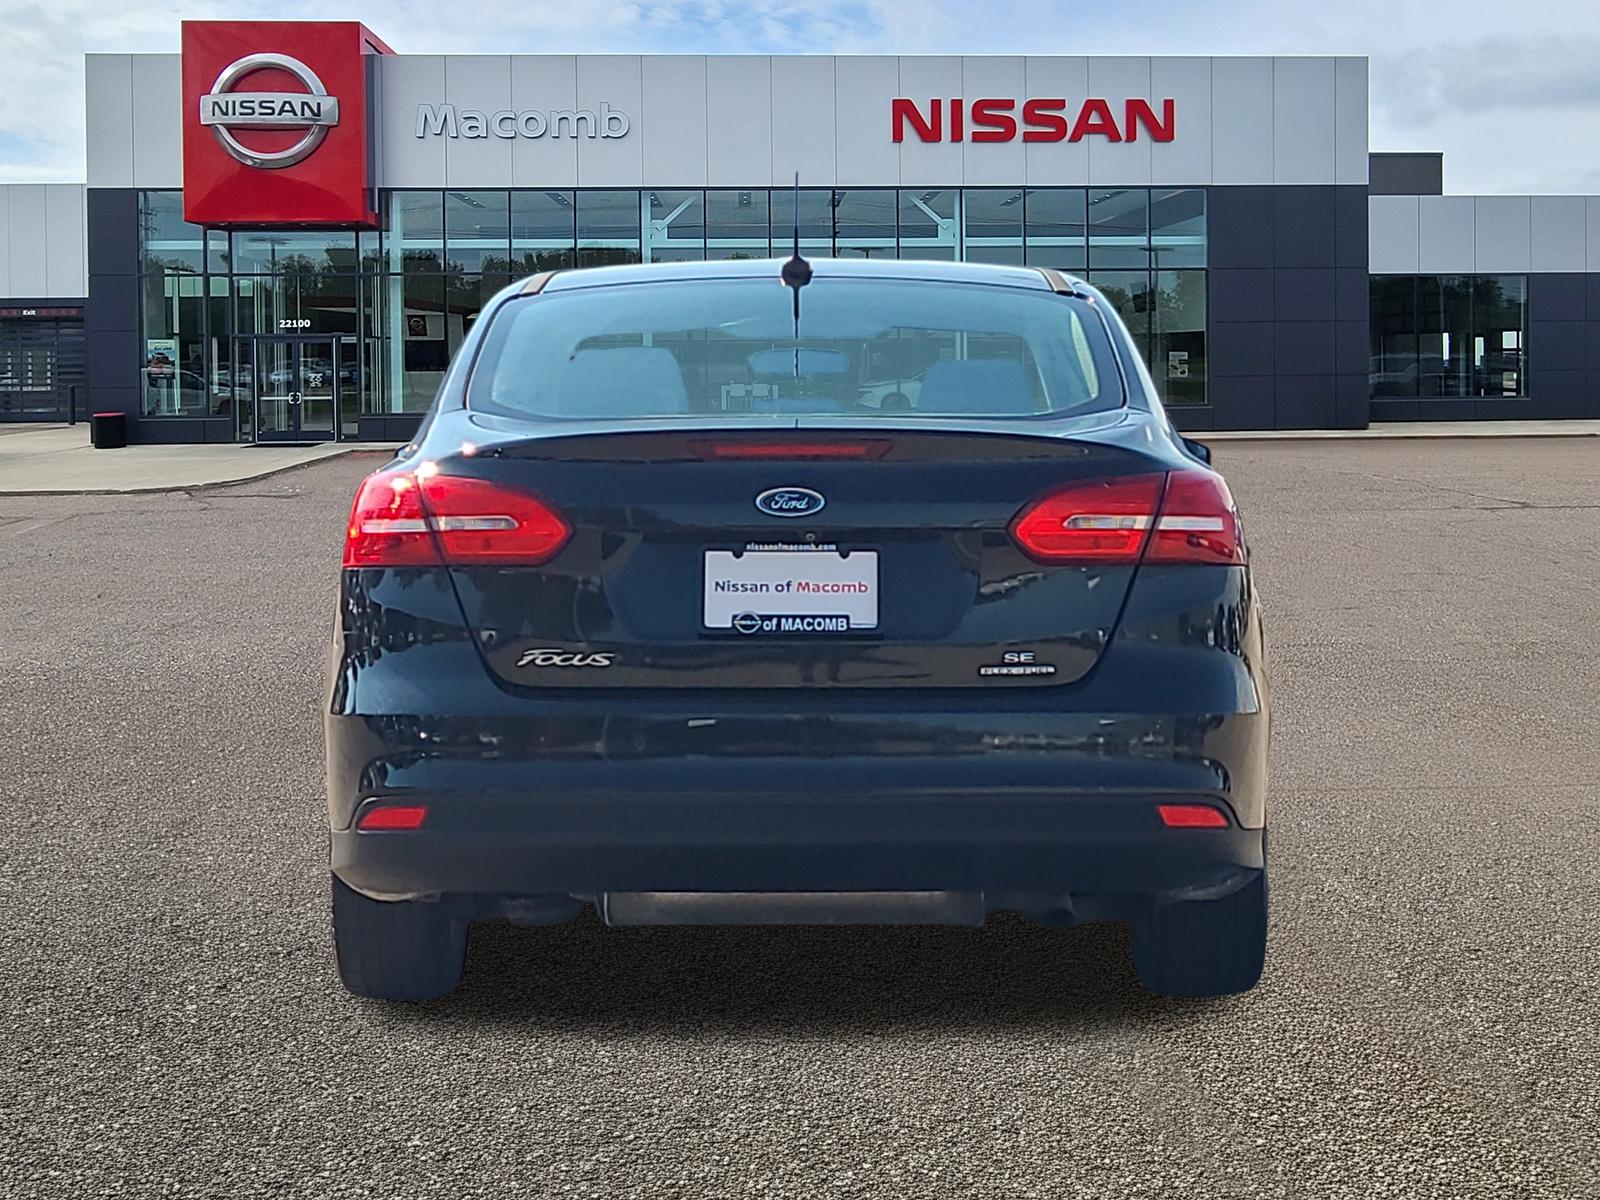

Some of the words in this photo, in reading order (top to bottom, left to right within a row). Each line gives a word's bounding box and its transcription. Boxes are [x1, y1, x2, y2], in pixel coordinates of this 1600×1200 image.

[211, 99, 322, 119] NISSAN
[415, 102, 631, 139] Macomb
[892, 98, 1176, 143] NISSAN
[279, 319, 311, 328] 22100
[770, 493, 809, 510] Ford
[714, 580, 770, 593] Nissan
[774, 580, 793, 593] of
[796, 581, 869, 594] Macomb
[763, 618, 778, 631] of
[781, 618, 848, 631] MACOMB
[1003, 652, 1036, 663] SE
